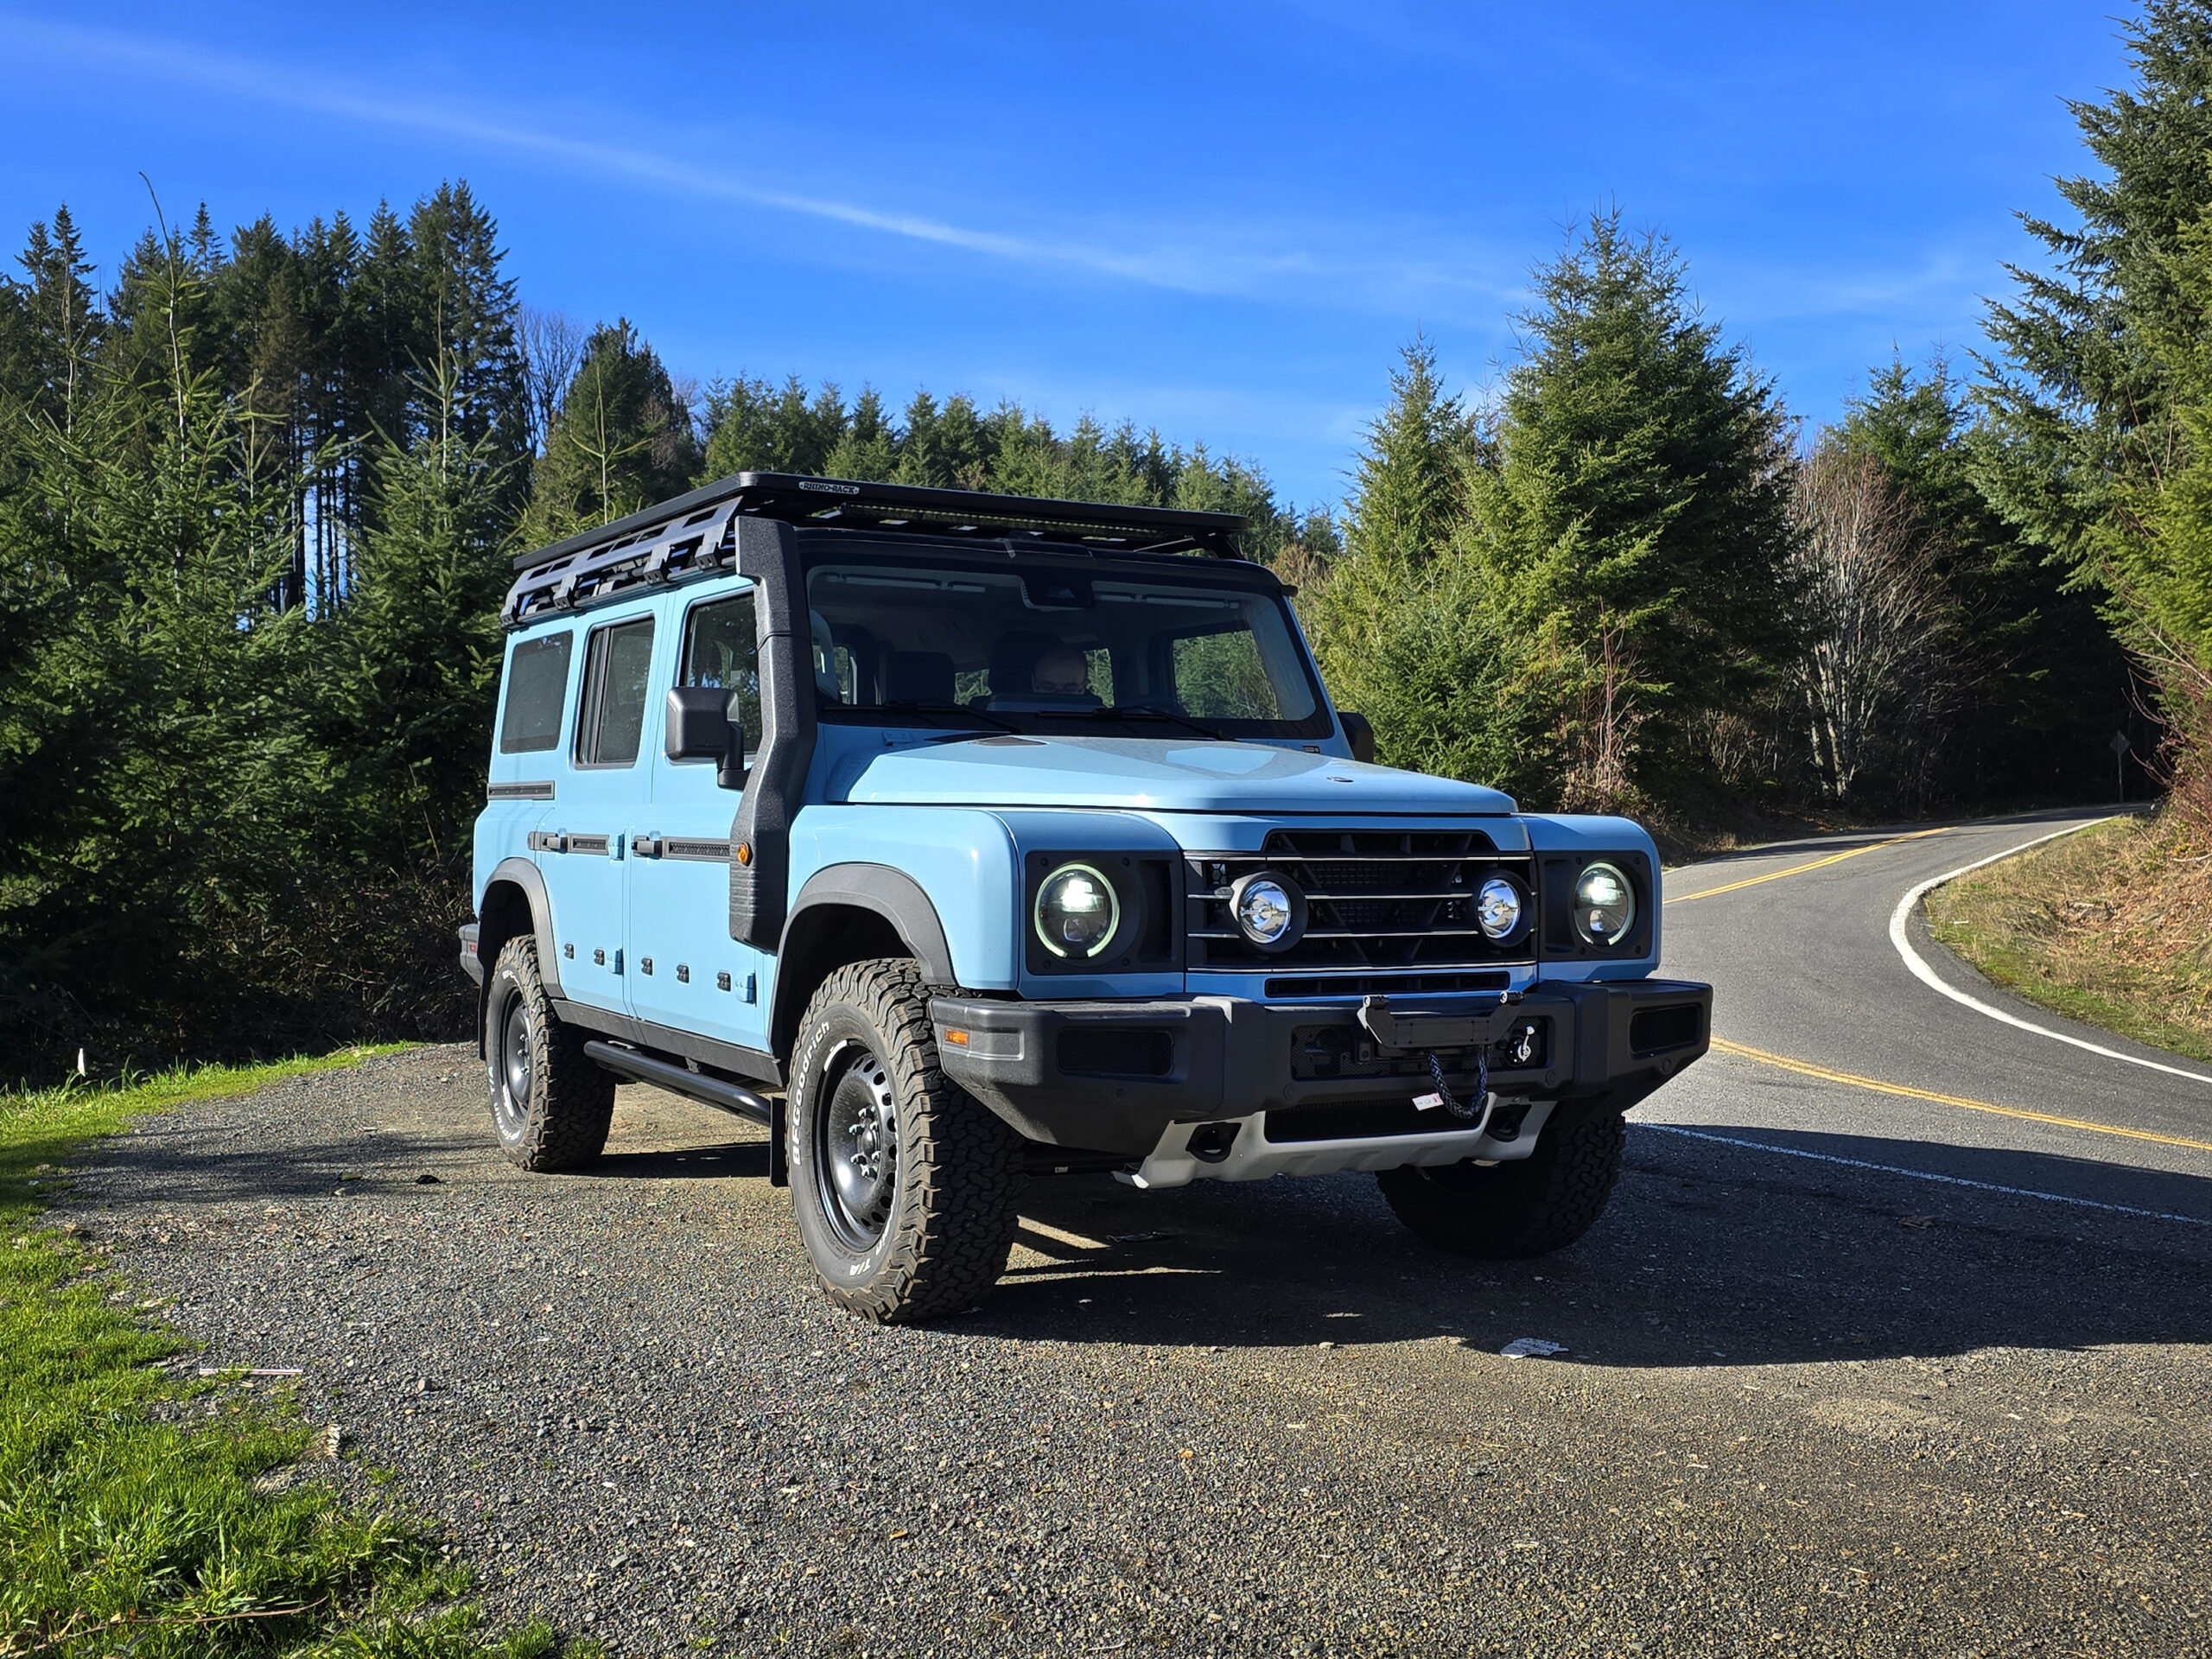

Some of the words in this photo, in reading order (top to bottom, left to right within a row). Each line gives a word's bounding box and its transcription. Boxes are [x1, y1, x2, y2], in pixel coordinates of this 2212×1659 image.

[804, 483, 855, 493] RHINO-RACK
[791, 1021, 830, 1166] BFGoodrich
[849, 1258, 871, 1276] T/A
